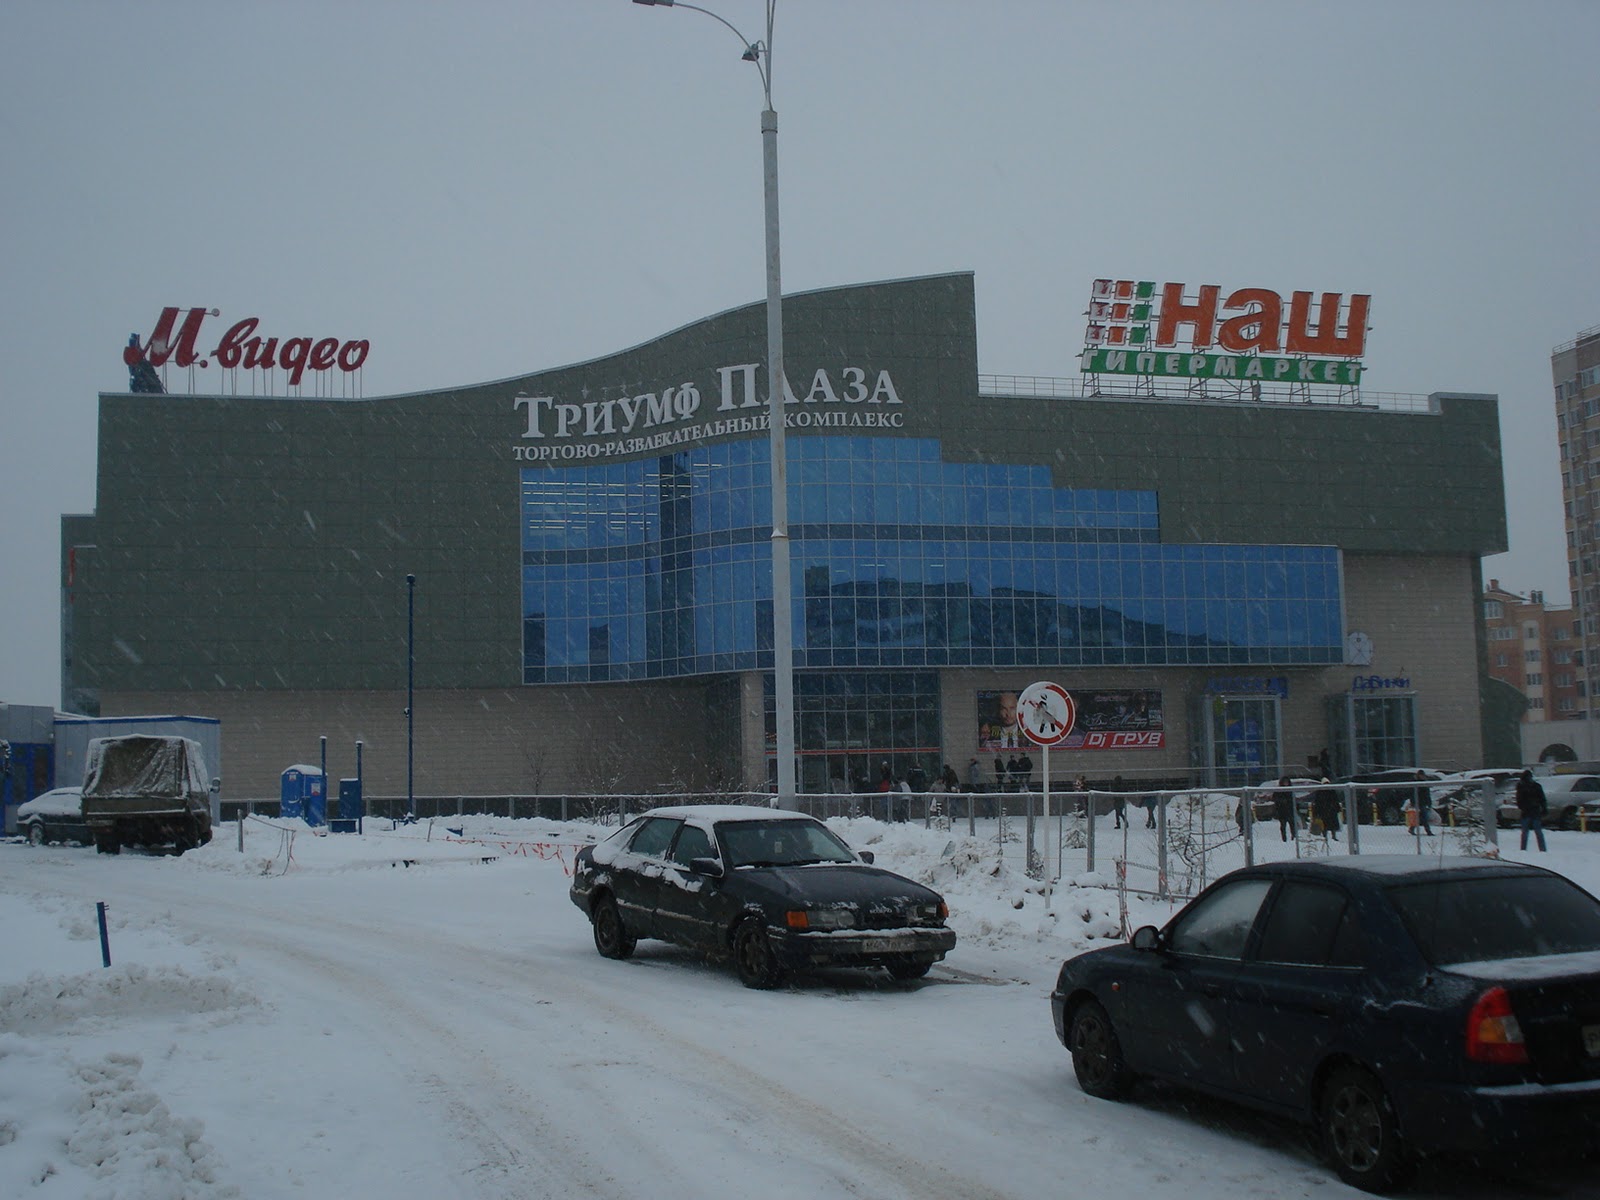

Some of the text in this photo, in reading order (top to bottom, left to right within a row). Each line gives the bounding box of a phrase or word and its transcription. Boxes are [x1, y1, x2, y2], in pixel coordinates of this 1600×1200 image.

[1081, 350, 1363, 383] ГИПЕРМАРКЕТ
[512, 411, 771, 461] ТОРГОВО-РАЗВЛЕКАТЕЛЬНЫЙ
[1088, 733, 1107, 748] Dj
[1112, 732, 1162, 745] ГРУВ
